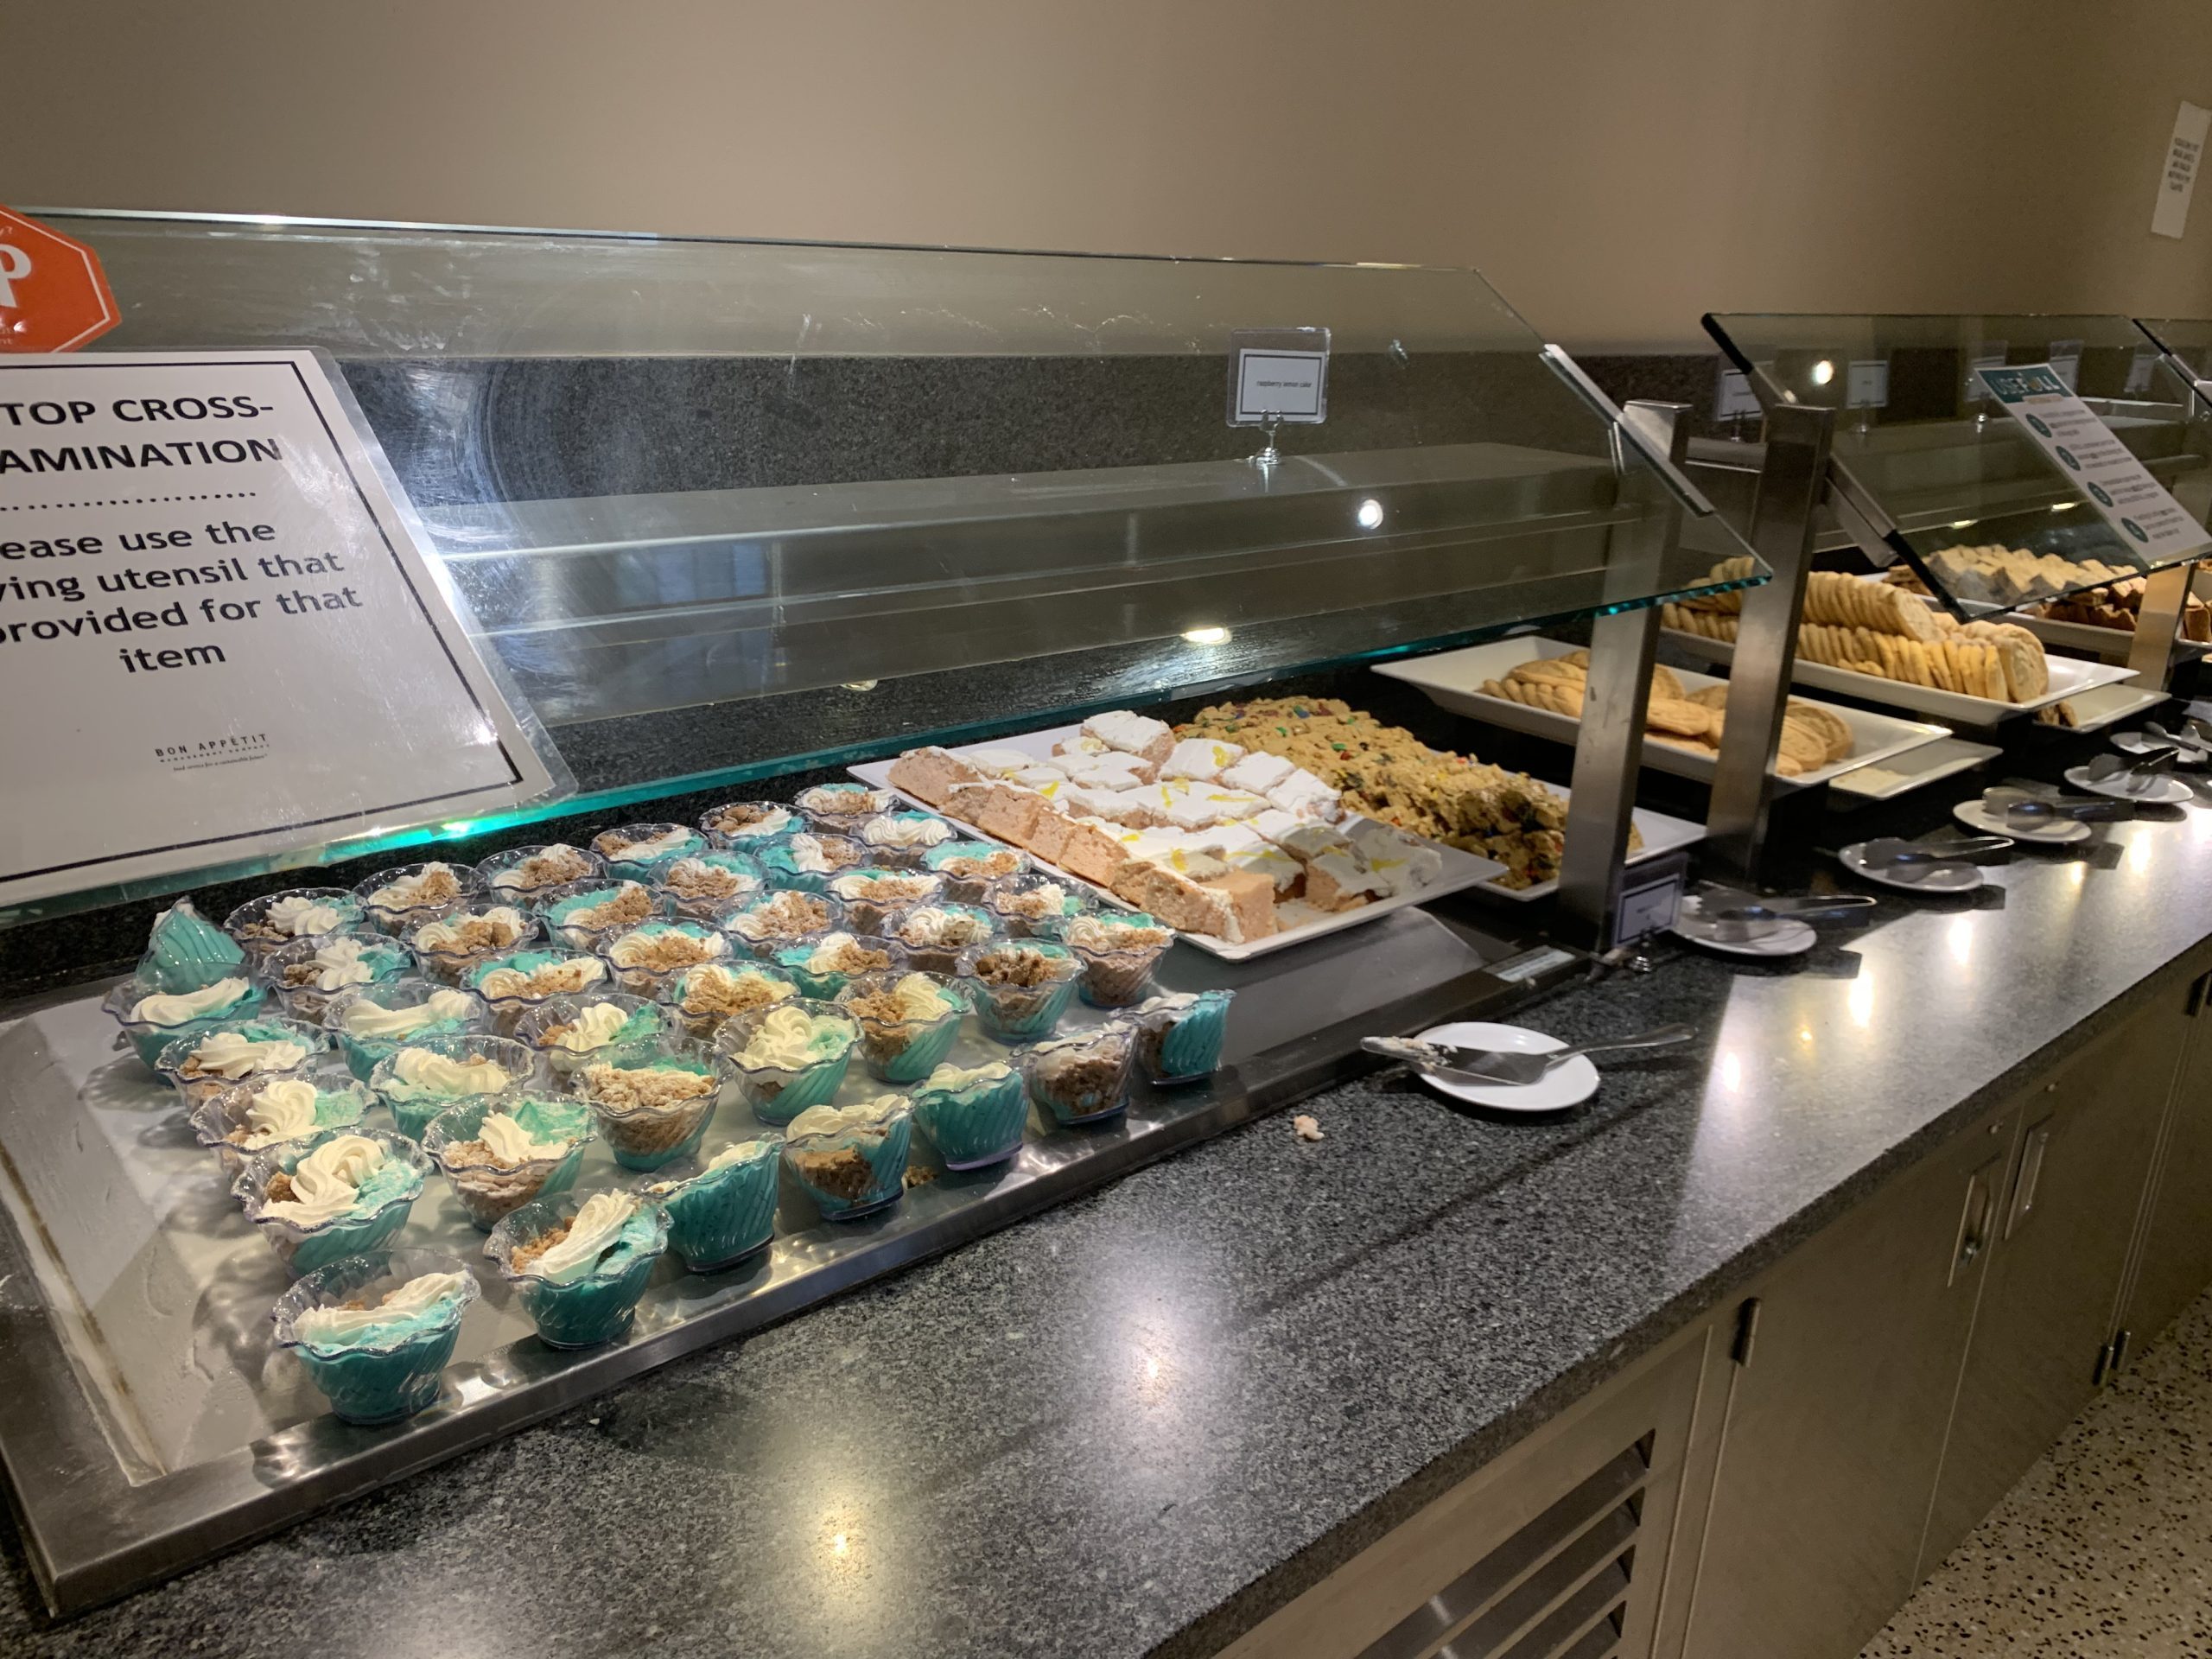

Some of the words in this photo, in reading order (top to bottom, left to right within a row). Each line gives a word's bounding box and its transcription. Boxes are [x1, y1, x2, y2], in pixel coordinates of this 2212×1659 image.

[112, 397, 274, 422] CROSS-
[119, 530, 192, 550] use
[205, 521, 276, 544] the
[97, 558, 248, 593] utensil
[257, 552, 345, 579] that
[200, 598, 261, 622] for
[276, 587, 363, 614] that
[119, 644, 226, 673] item
[156, 746, 187, 757] BON
